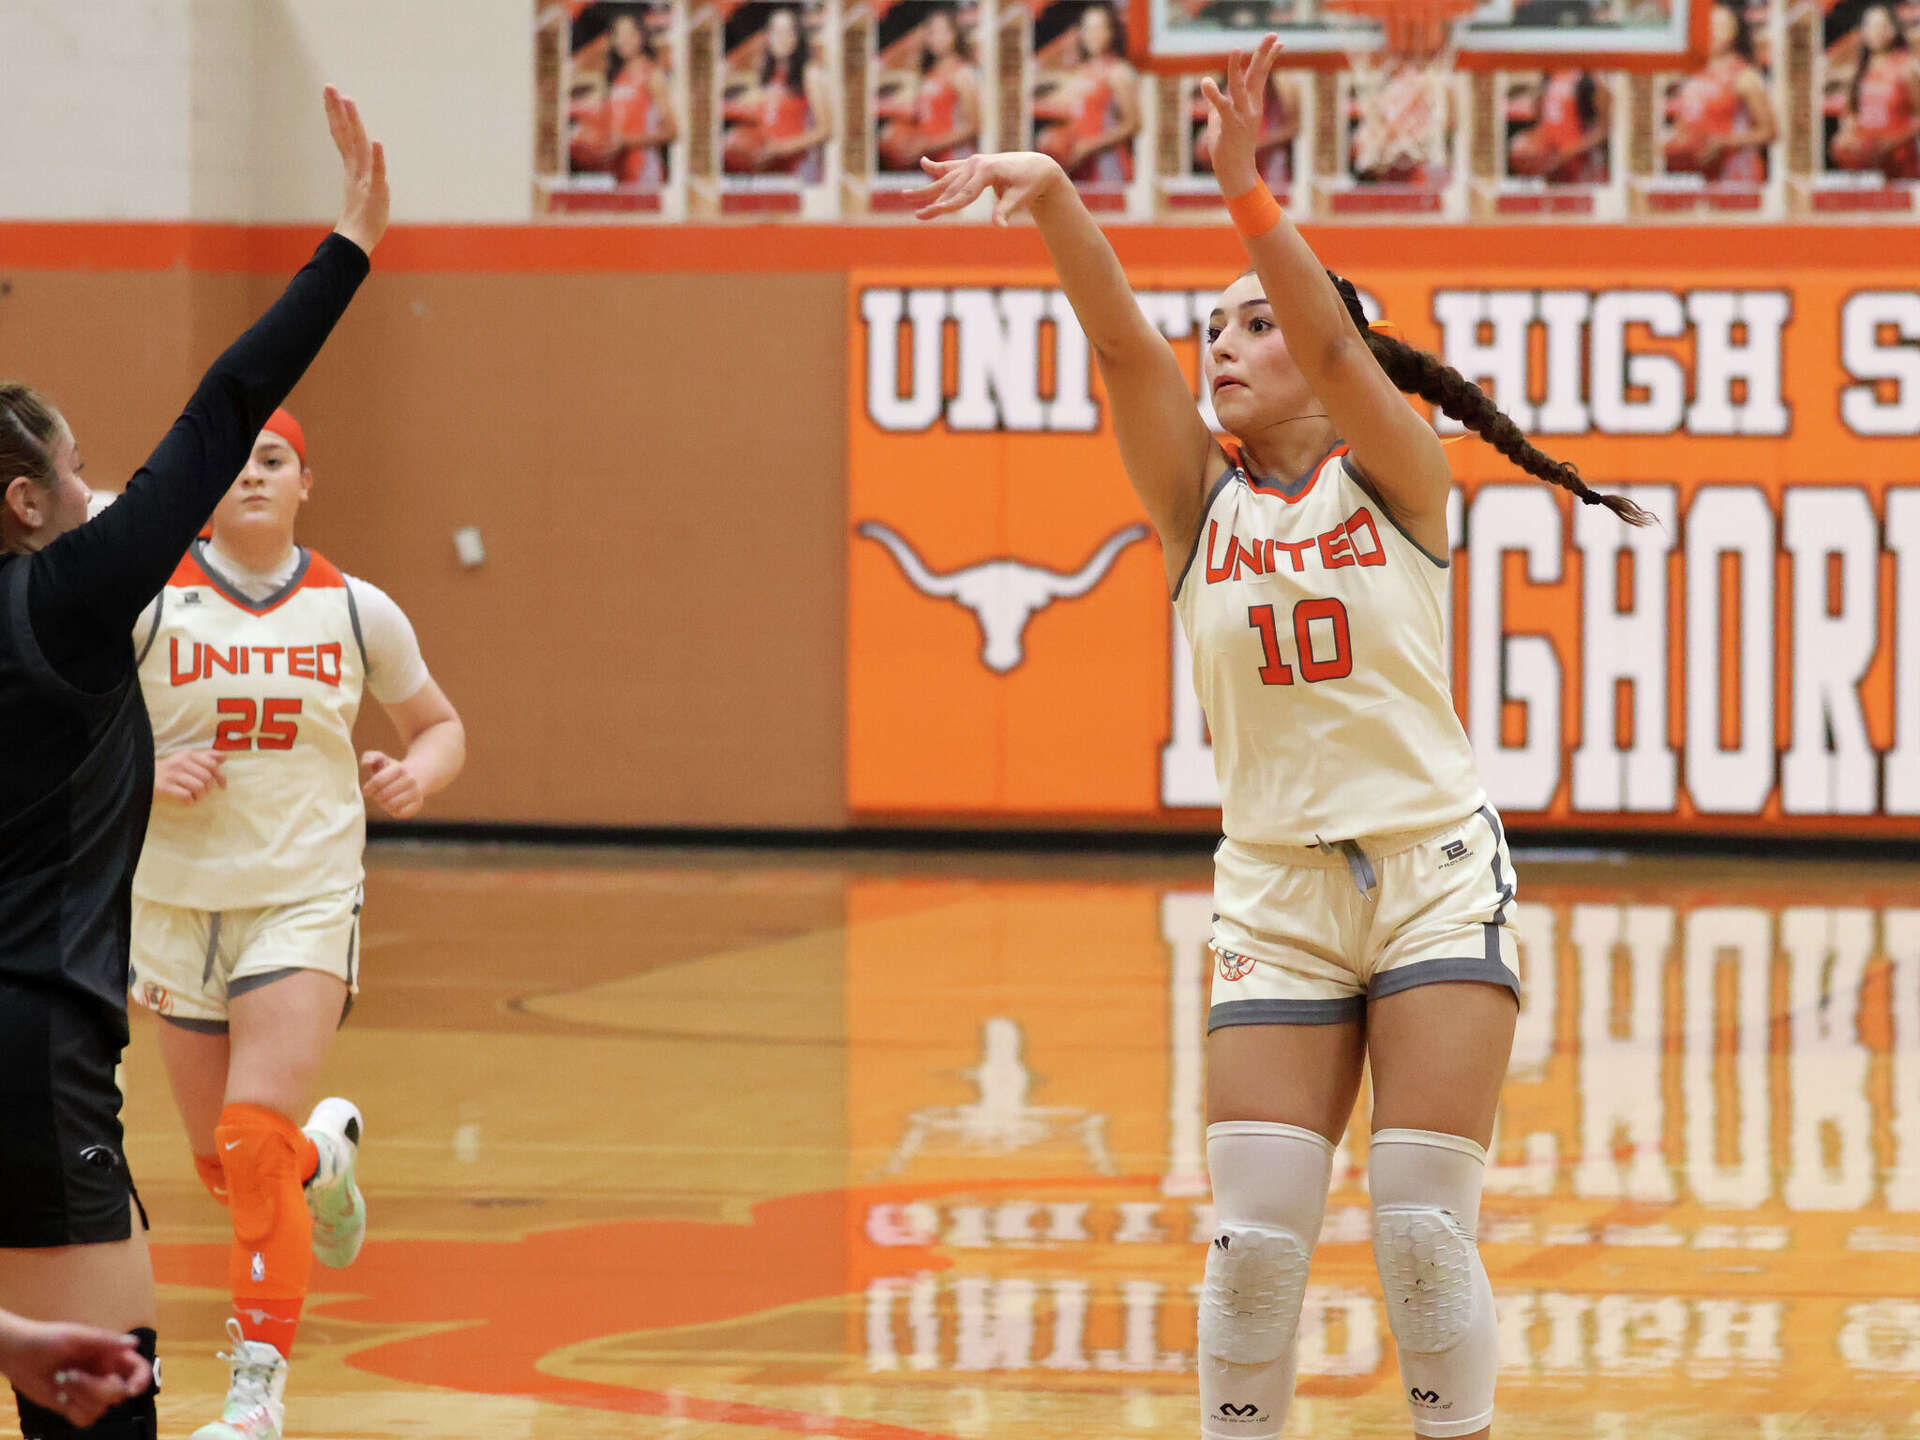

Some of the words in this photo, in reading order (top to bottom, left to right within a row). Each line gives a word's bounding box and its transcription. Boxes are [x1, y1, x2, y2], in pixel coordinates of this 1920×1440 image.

[861, 287, 1383, 434] UNI
[1433, 289, 1792, 437] HIGH
[1206, 506, 1387, 585] UNITED
[170, 636, 342, 688] UNITED
[1248, 597, 1353, 686] 10
[212, 697, 303, 751] 25
